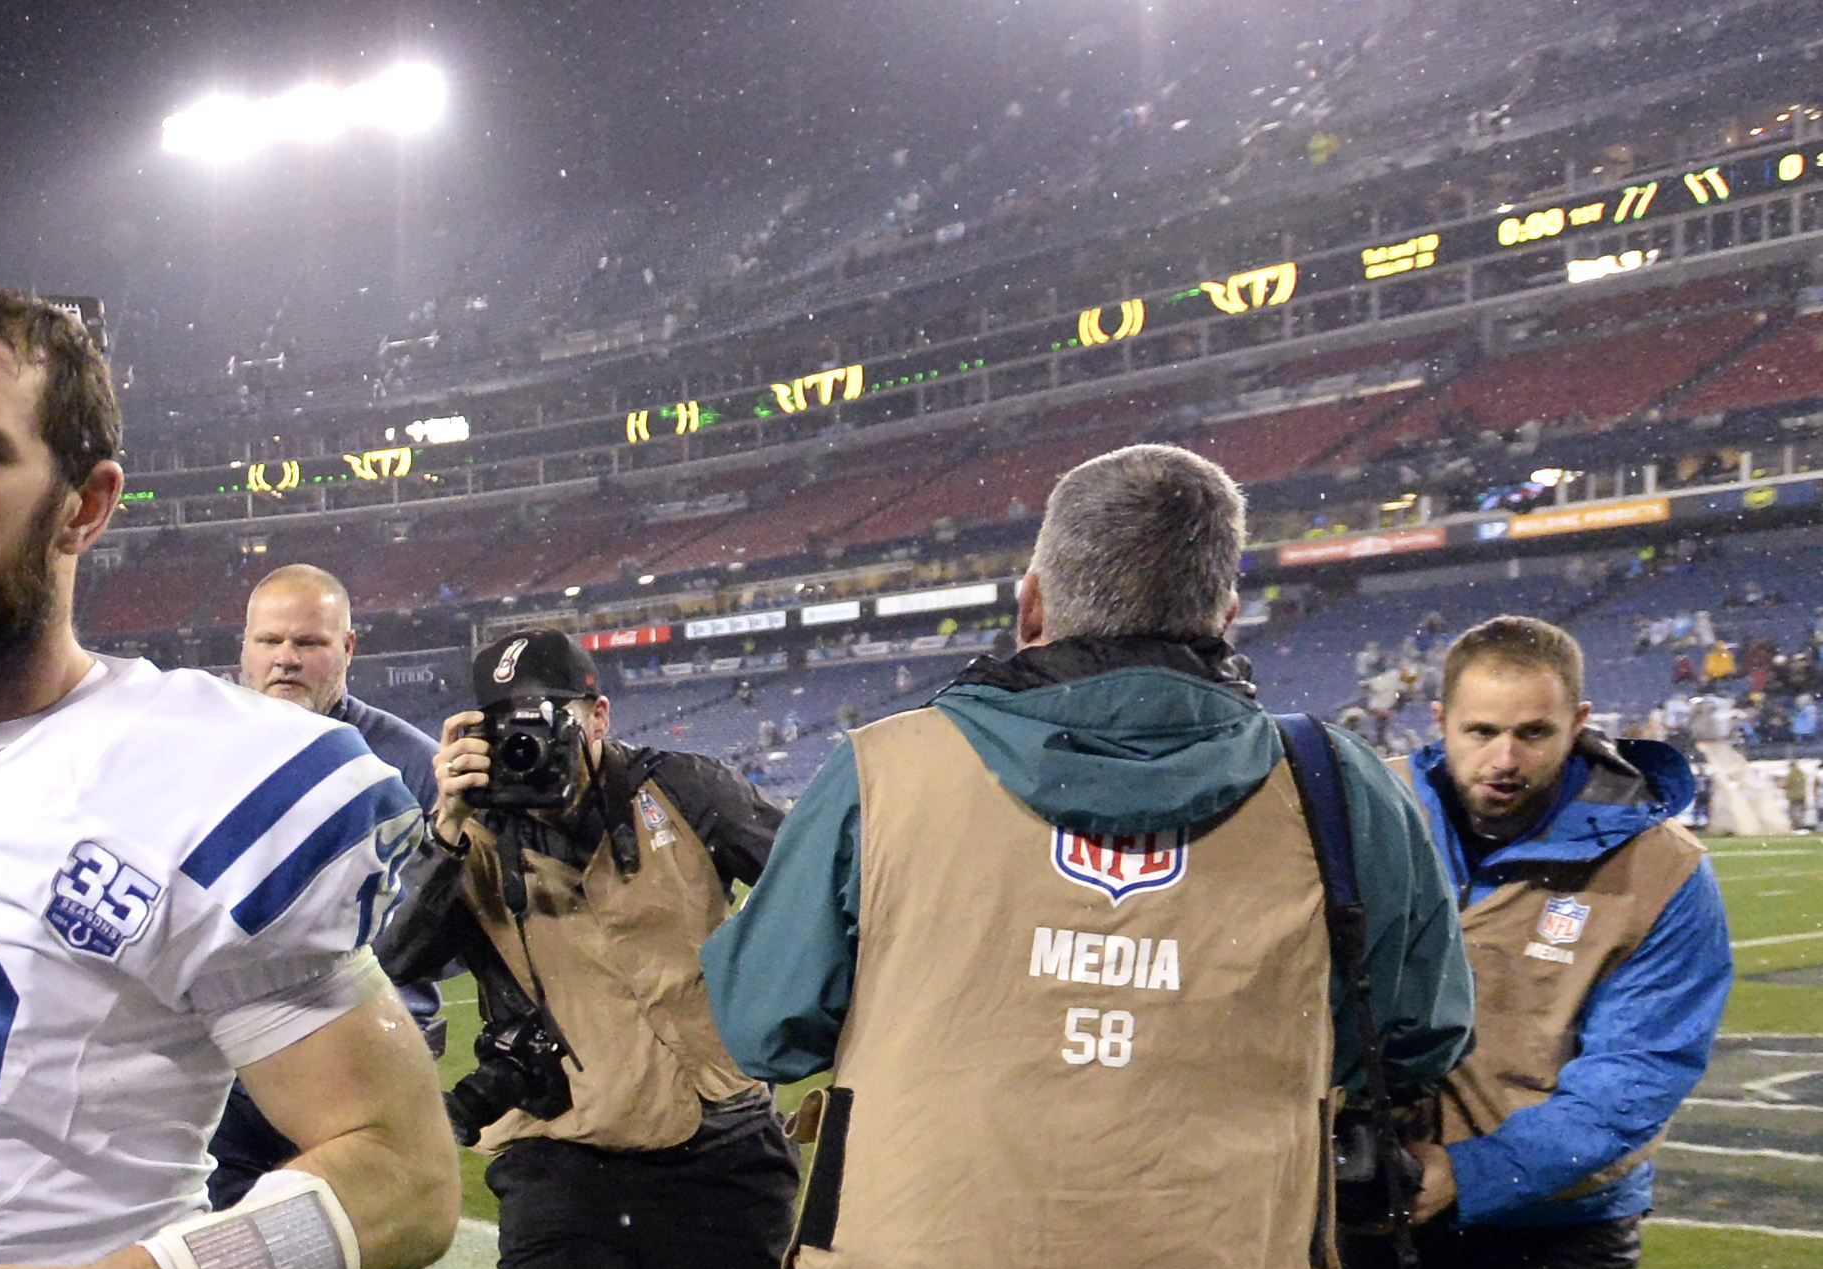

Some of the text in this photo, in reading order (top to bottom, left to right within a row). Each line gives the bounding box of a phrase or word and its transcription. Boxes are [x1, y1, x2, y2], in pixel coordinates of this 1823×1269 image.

[55, 841, 162, 937] 35
[60, 897, 121, 940] SEASONS
[1543, 913, 1574, 937] NFL
[1028, 926, 1180, 991] MEDIA
[1061, 1006, 1135, 1068] 58
